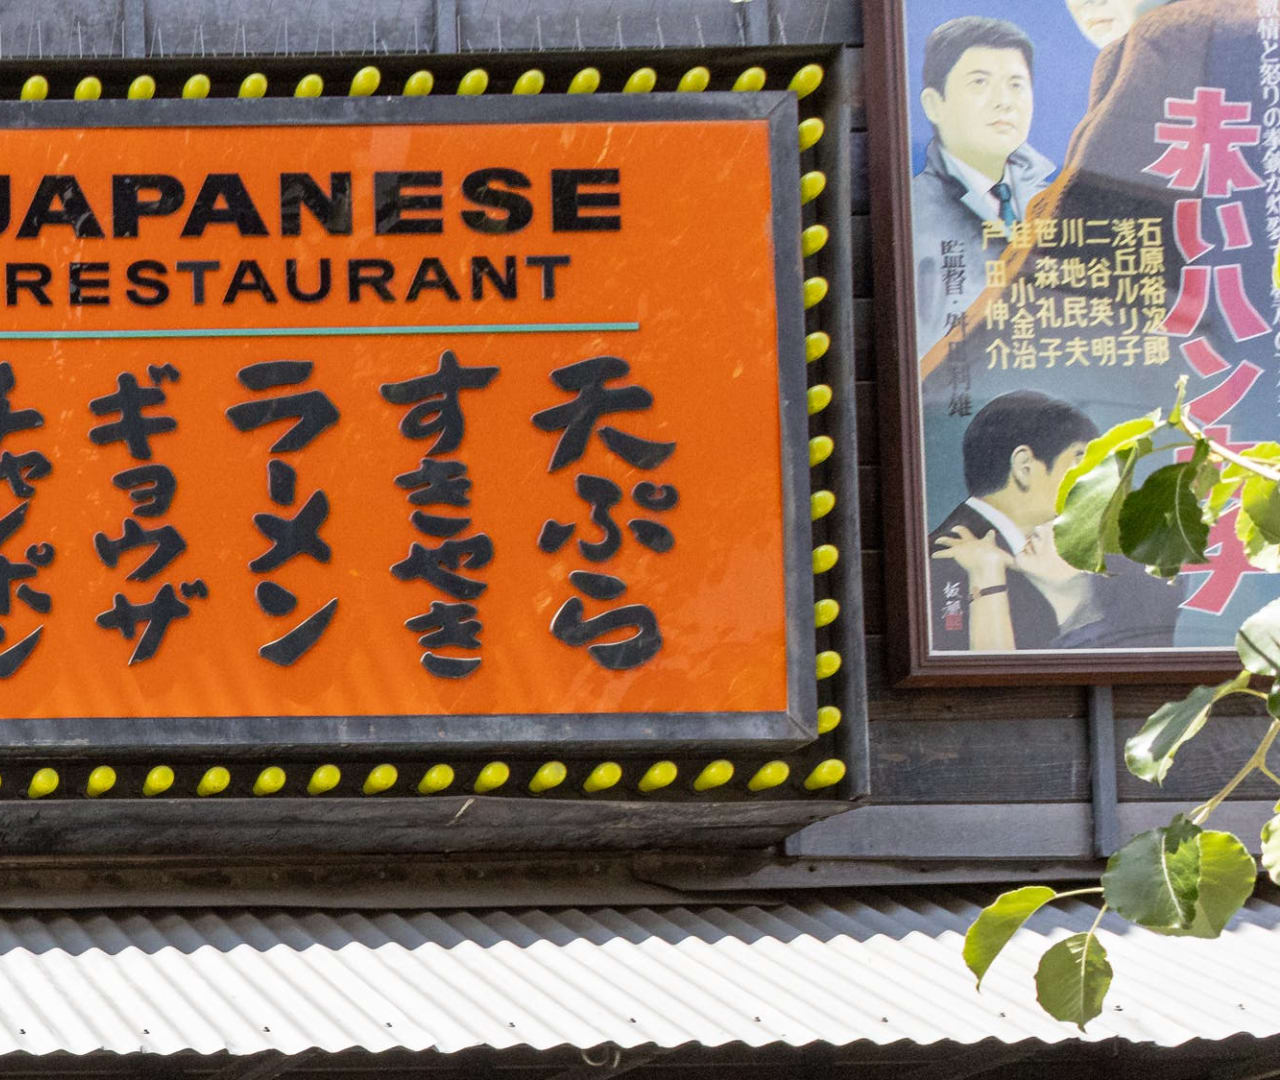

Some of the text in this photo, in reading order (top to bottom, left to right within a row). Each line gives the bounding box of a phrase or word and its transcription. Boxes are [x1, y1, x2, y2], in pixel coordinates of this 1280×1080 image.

[6, 254, 571, 307] RESTAURANT
[1034, 217, 1063, 368] 笹森礼子
[1060, 218, 1090, 367] 川地民夫
[1085, 219, 1117, 366] 二谷英明
[1112, 218, 1141, 367] 浅丘ルリ子
[1137, 217, 1170, 365] 石原裕次郎
[1142, 87, 1278, 616] 赤いハンチ
[88, 363, 208, 667] ギョウザ
[225, 360, 341, 666] ラーメン
[380, 349, 500, 679] すきやき
[530, 354, 680, 671] 天ぷら
